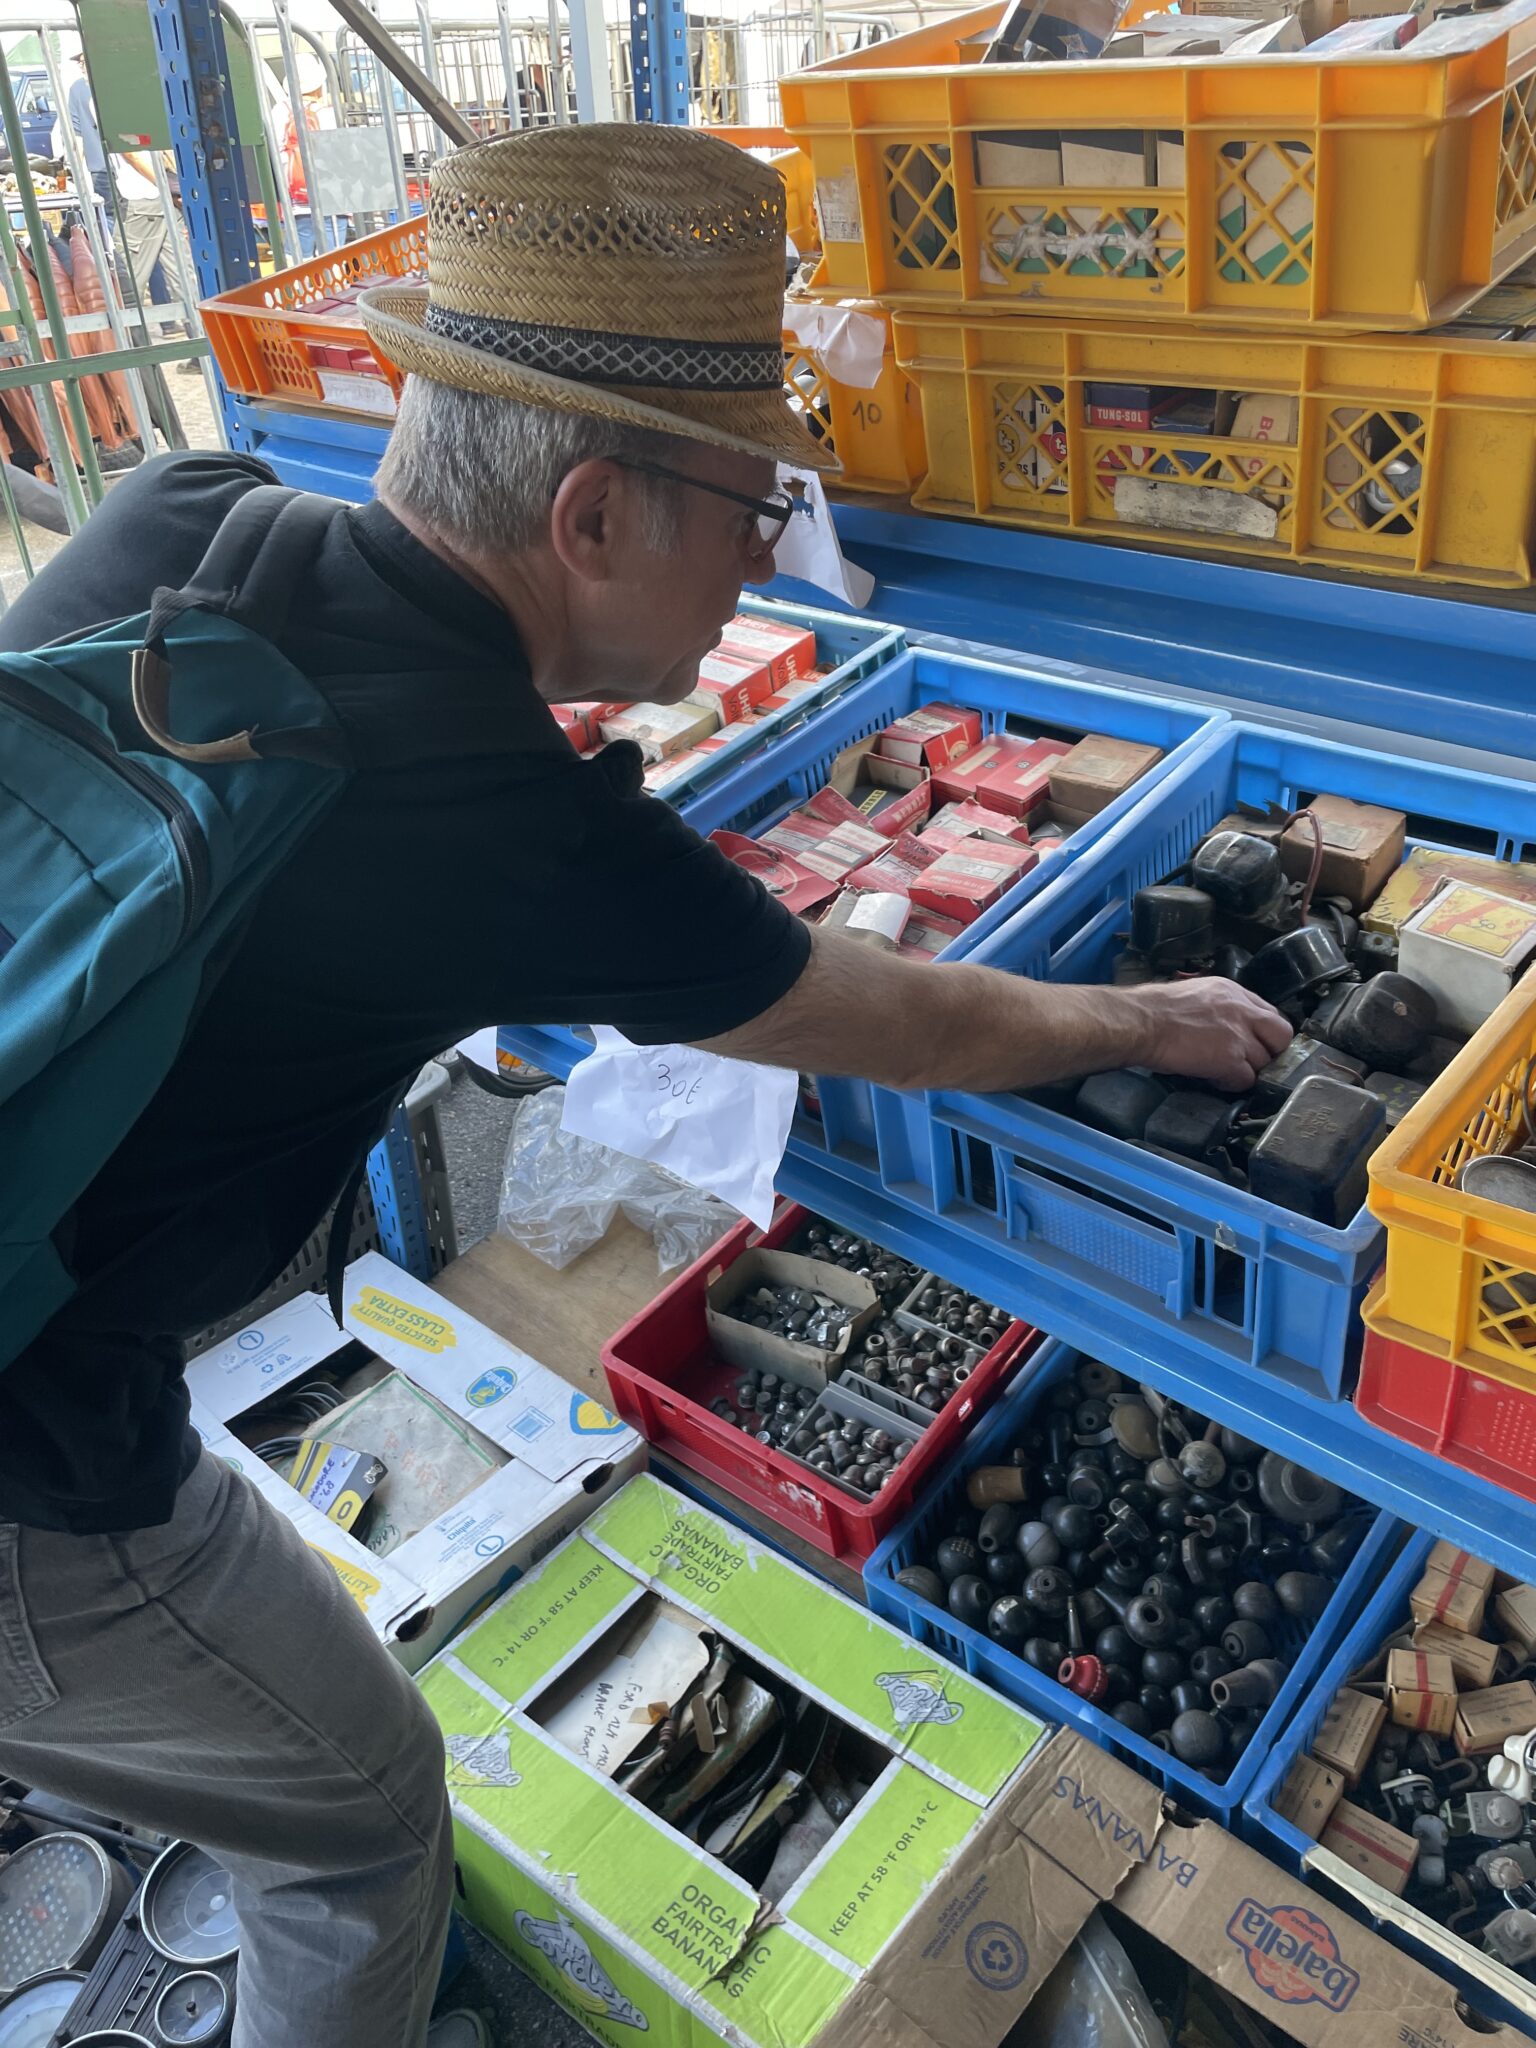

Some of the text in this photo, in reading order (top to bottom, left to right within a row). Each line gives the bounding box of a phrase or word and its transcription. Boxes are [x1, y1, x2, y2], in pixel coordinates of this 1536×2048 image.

[852, 400, 882, 432] 10
[1097, 408, 1144, 423] TUNG-SOL
[786, 653, 799, 683] UHE
[737, 688, 753, 720] UHE
[356, 1306, 440, 1348] SELECTED QUALITY
[370, 1295, 445, 1336] CLASS EXTRA
[484, 1369, 514, 1395] Chiquita
[446, 1517, 477, 1541] Chiquita
[671, 1519, 745, 1570] BANANAS
[334, 1567, 374, 1592] UALITY
[577, 1563, 606, 1591] KEEP
[648, 1543, 721, 1594] ORGAIC
[548, 1602, 565, 1617] 58
[562, 1586, 579, 1605] AT
[505, 1640, 522, 1655] 14
[519, 1624, 540, 1644] OR
[1051, 1775, 1199, 1889] BANANAS
[829, 1901, 859, 1937] KEEP
[856, 1881, 875, 1903] AT
[871, 1865, 889, 1884] 58
[895, 1832, 915, 1852] OR
[910, 1815, 928, 1832] 14
[651, 1915, 745, 1999] BANANAS
[665, 1901, 757, 1984] FAIRTRADE
[1241, 1906, 1350, 2003] bajella
